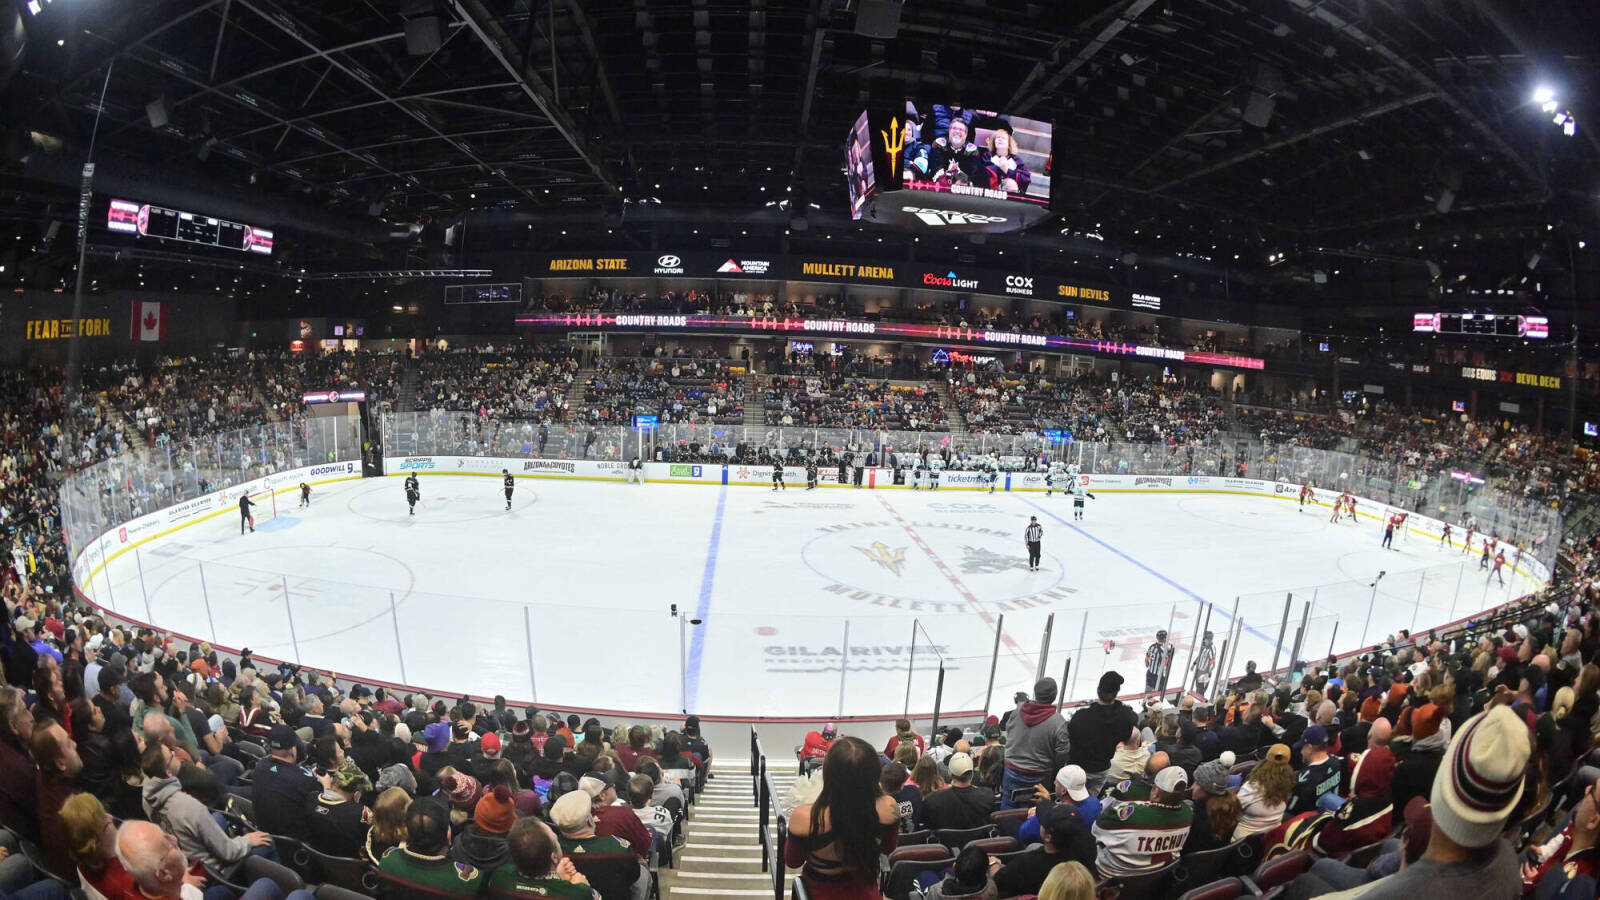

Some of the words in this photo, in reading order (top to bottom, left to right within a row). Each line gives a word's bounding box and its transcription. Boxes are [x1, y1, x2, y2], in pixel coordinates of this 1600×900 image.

[951, 184, 983, 196] COUNTRY
[984, 188, 1007, 199] ROADS
[550, 259, 593, 270] ARIZONA
[596, 258, 627, 269] STATE
[803, 262, 855, 277] MULLETT
[858, 266, 894, 279] ARENA
[923, 273, 952, 286] Coors
[952, 279, 978, 289] LIGHT
[1006, 275, 1033, 288] COX
[1006, 287, 1033, 295] BUSINESS
[1059, 285, 1078, 297] SUN
[1080, 287, 1110, 301] DEVILS
[615, 315, 656, 326] COUNTRY
[657, 316, 687, 327] ROADS
[803, 320, 844, 332] COUNTRY
[845, 323, 876, 334] ROADS
[26, 319, 59, 340] FEAR
[79, 318, 110, 337] FORK
[984, 331, 1020, 344] COUNTRY
[1021, 334, 1047, 346] ROADS
[1136, 345, 1165, 357] COUNTRY
[1462, 366, 1475, 379] DOS
[1516, 372, 1538, 386] DEVIL
[1540, 375, 1561, 389] DECK
[311, 464, 345, 476] GOODWILL
[400, 461, 435, 470] SPORTS
[550, 461, 575, 473] COYOTES
[947, 474, 1000, 484] ticketmasr
[822, 584, 967, 613] MULLETT
[995, 586, 1079, 612] ARENA
[764, 645, 843, 656] GILA
[849, 645, 951, 656] RIVER
[900, 803, 913, 815] 82
